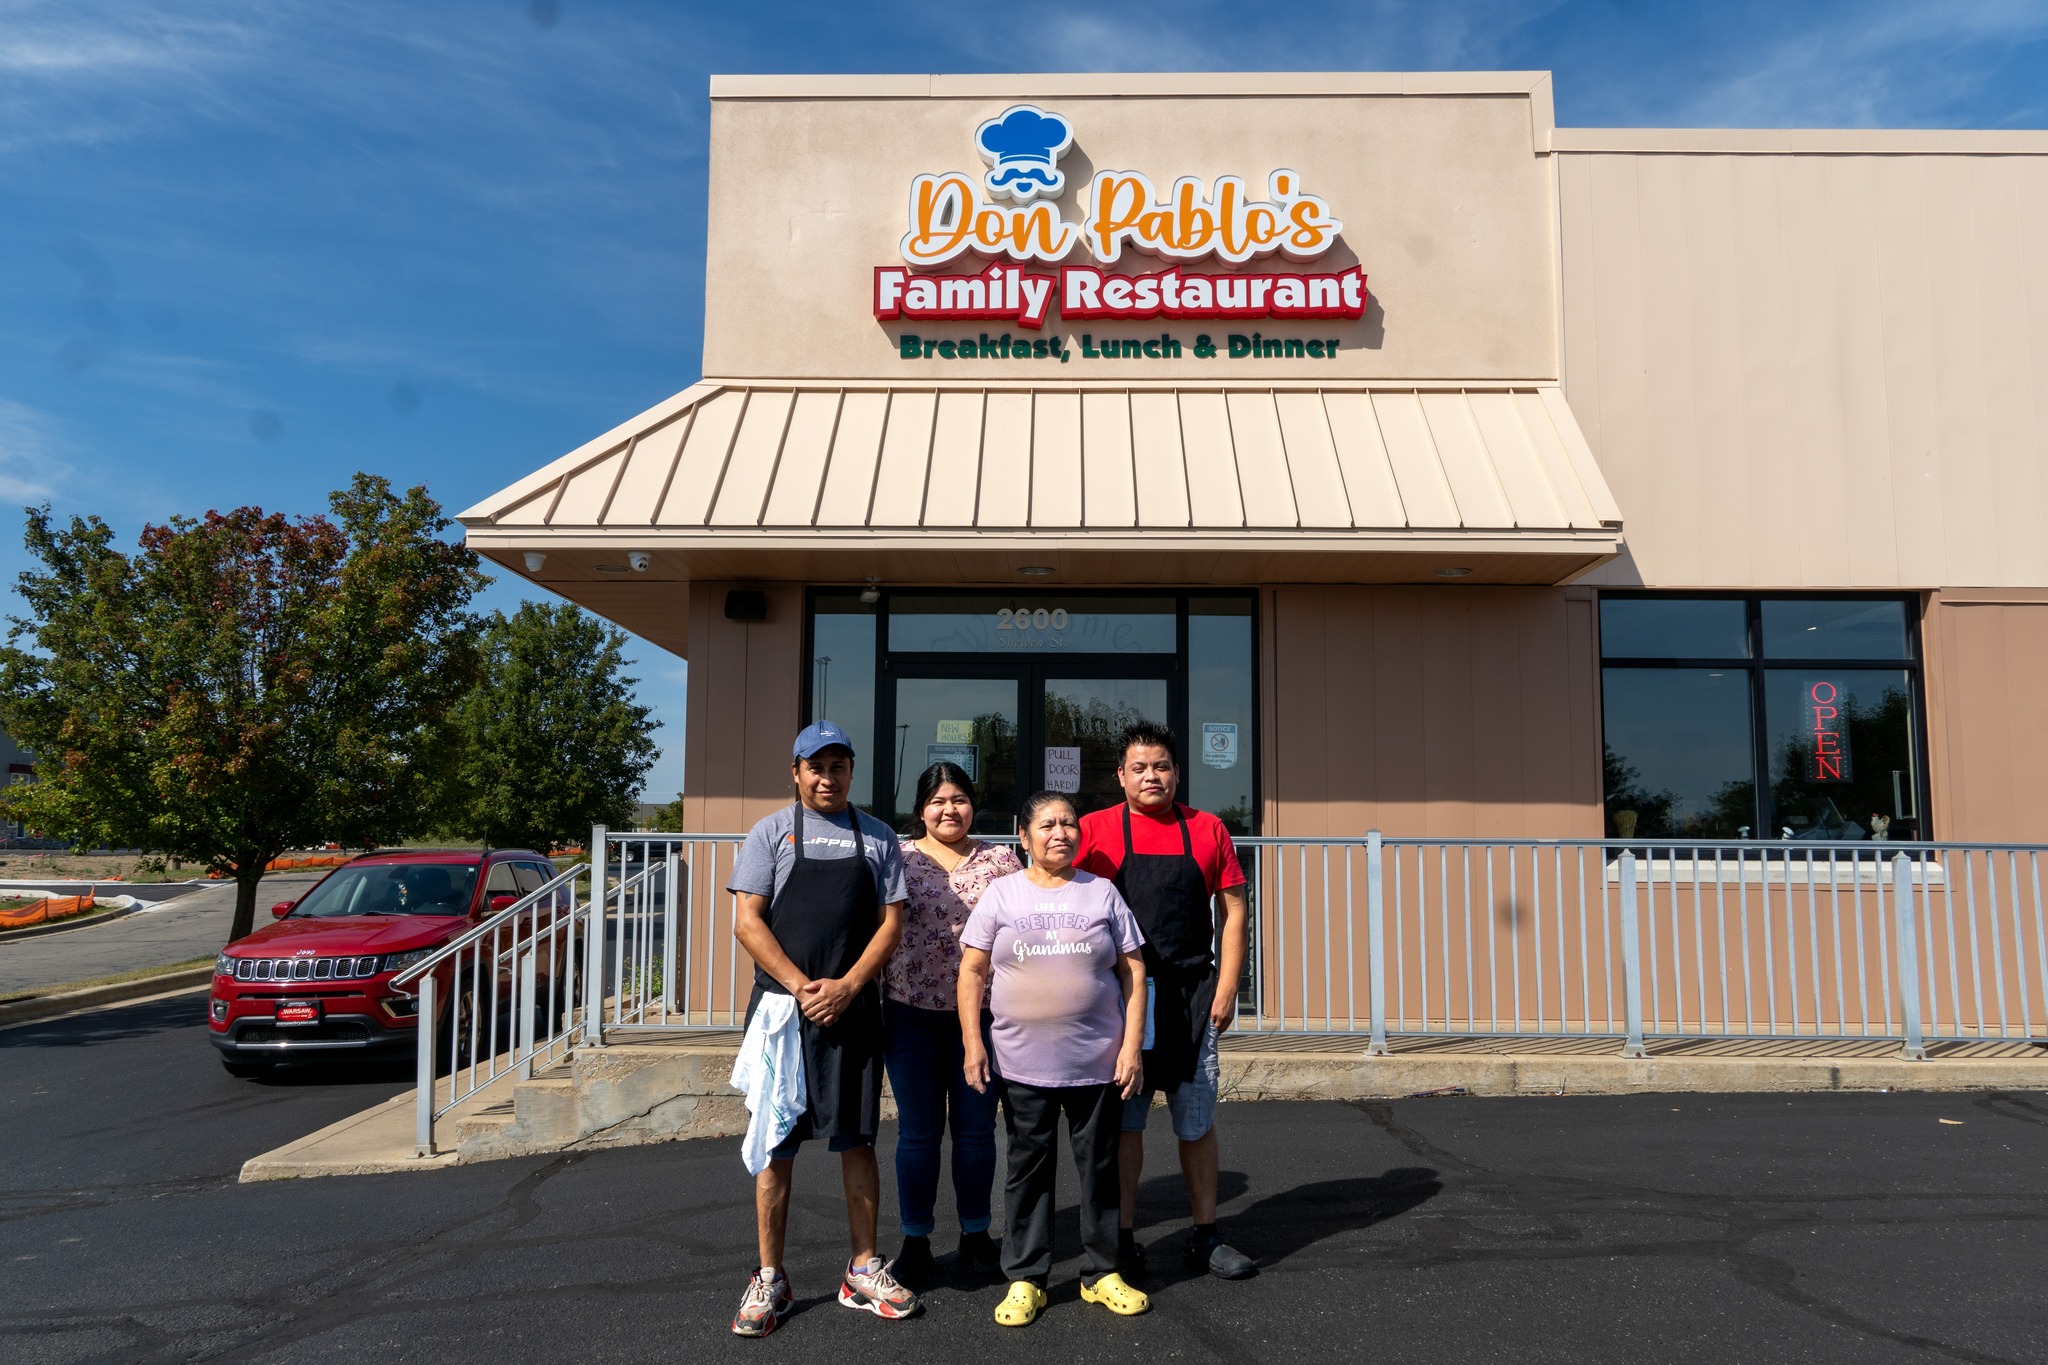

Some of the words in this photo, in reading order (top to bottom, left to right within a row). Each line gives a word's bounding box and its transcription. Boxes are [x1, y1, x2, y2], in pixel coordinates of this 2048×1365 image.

[909, 174, 1069, 258] Don
[1093, 174, 1332, 257] Pablo's
[879, 268, 1051, 318] Family
[1066, 270, 1362, 309] Restaurant
[900, 333, 1071, 363] Breakfast,
[1082, 333, 1181, 360] Lunch
[1193, 334, 1217, 359] &
[1228, 332, 1341, 359] Dinner
[996, 608, 1068, 630] 2600
[997, 634, 1044, 648] Shelden
[1049, 634, 1067, 648] St.
[941, 723, 960, 733] NEW
[1811, 681, 1842, 779] OPEN
[1048, 749, 1075, 760] PULL
[1049, 764, 1079, 775] DOORS
[1047, 780, 1078, 790] HARD!!
[1034, 903, 1055, 912] LIFE
[1058, 903, 1068, 912] IS
[1015, 912, 1090, 935] BETTER
[1045, 930, 1058, 941] AT
[1012, 939, 1093, 962] Grandmas
